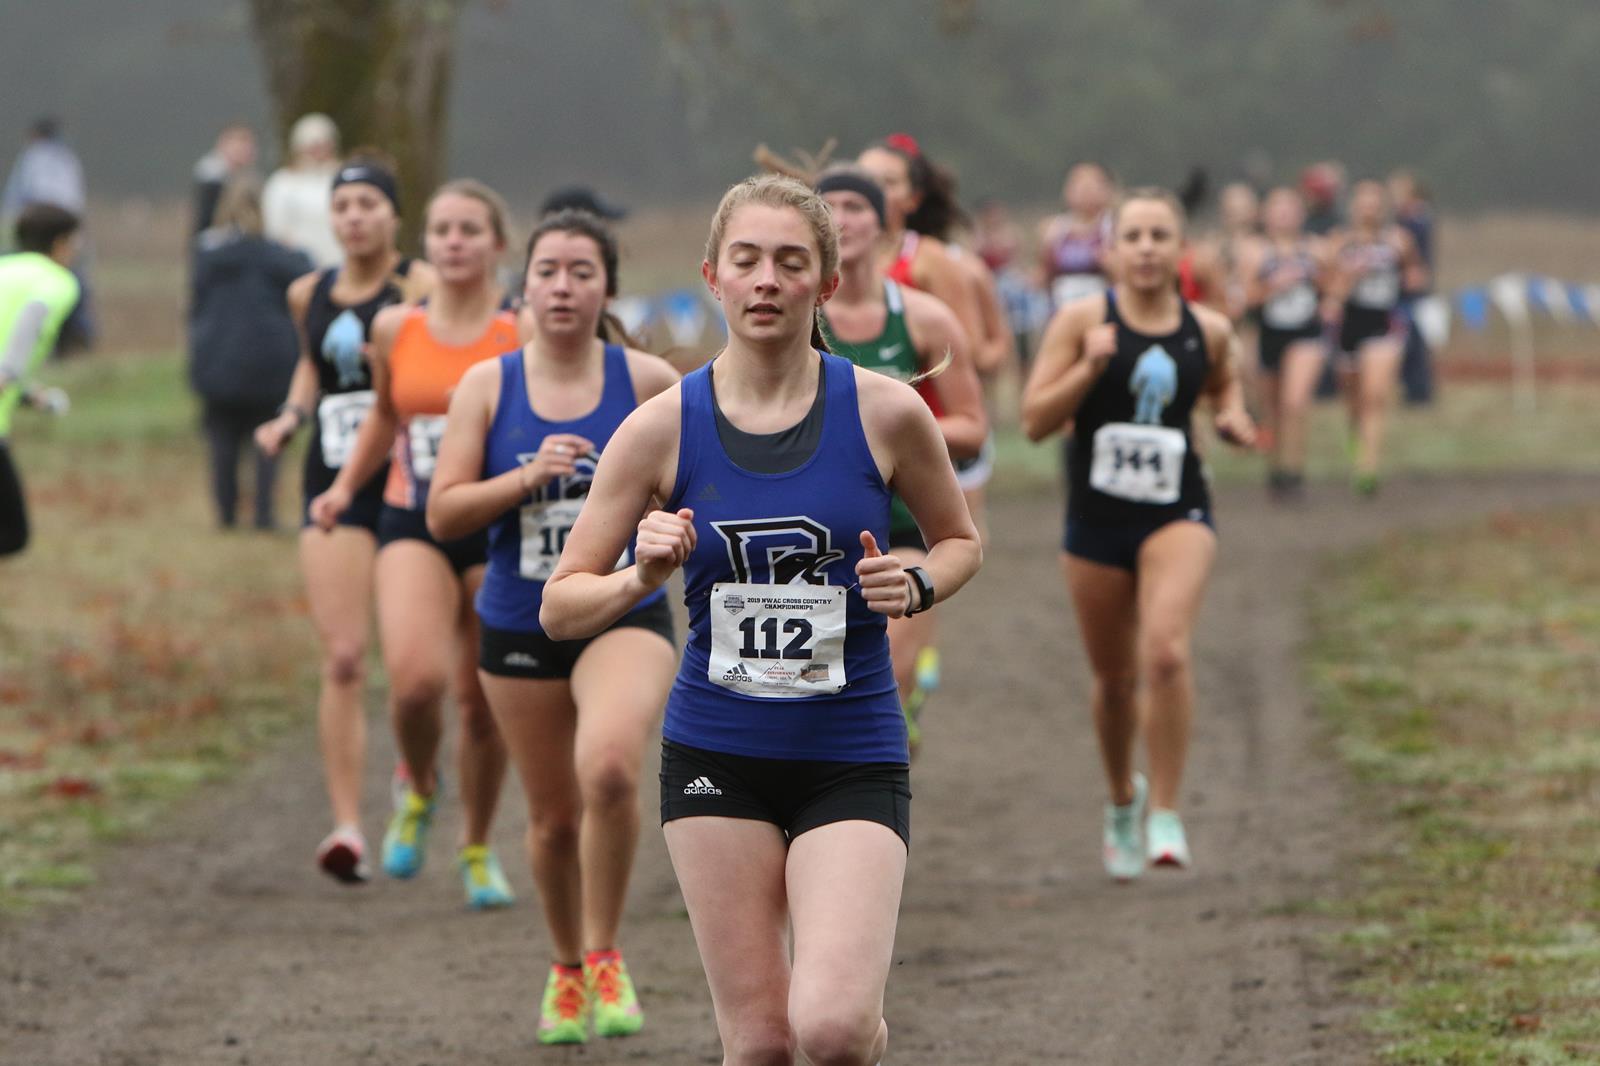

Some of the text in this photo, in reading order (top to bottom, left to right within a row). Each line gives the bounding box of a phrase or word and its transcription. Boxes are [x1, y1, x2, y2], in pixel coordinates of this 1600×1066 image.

[803, 598, 833, 606] COUNTRY
[738, 616, 813, 660] 112
[722, 674, 753, 683] adidas
[683, 786, 723, 796] adidas
